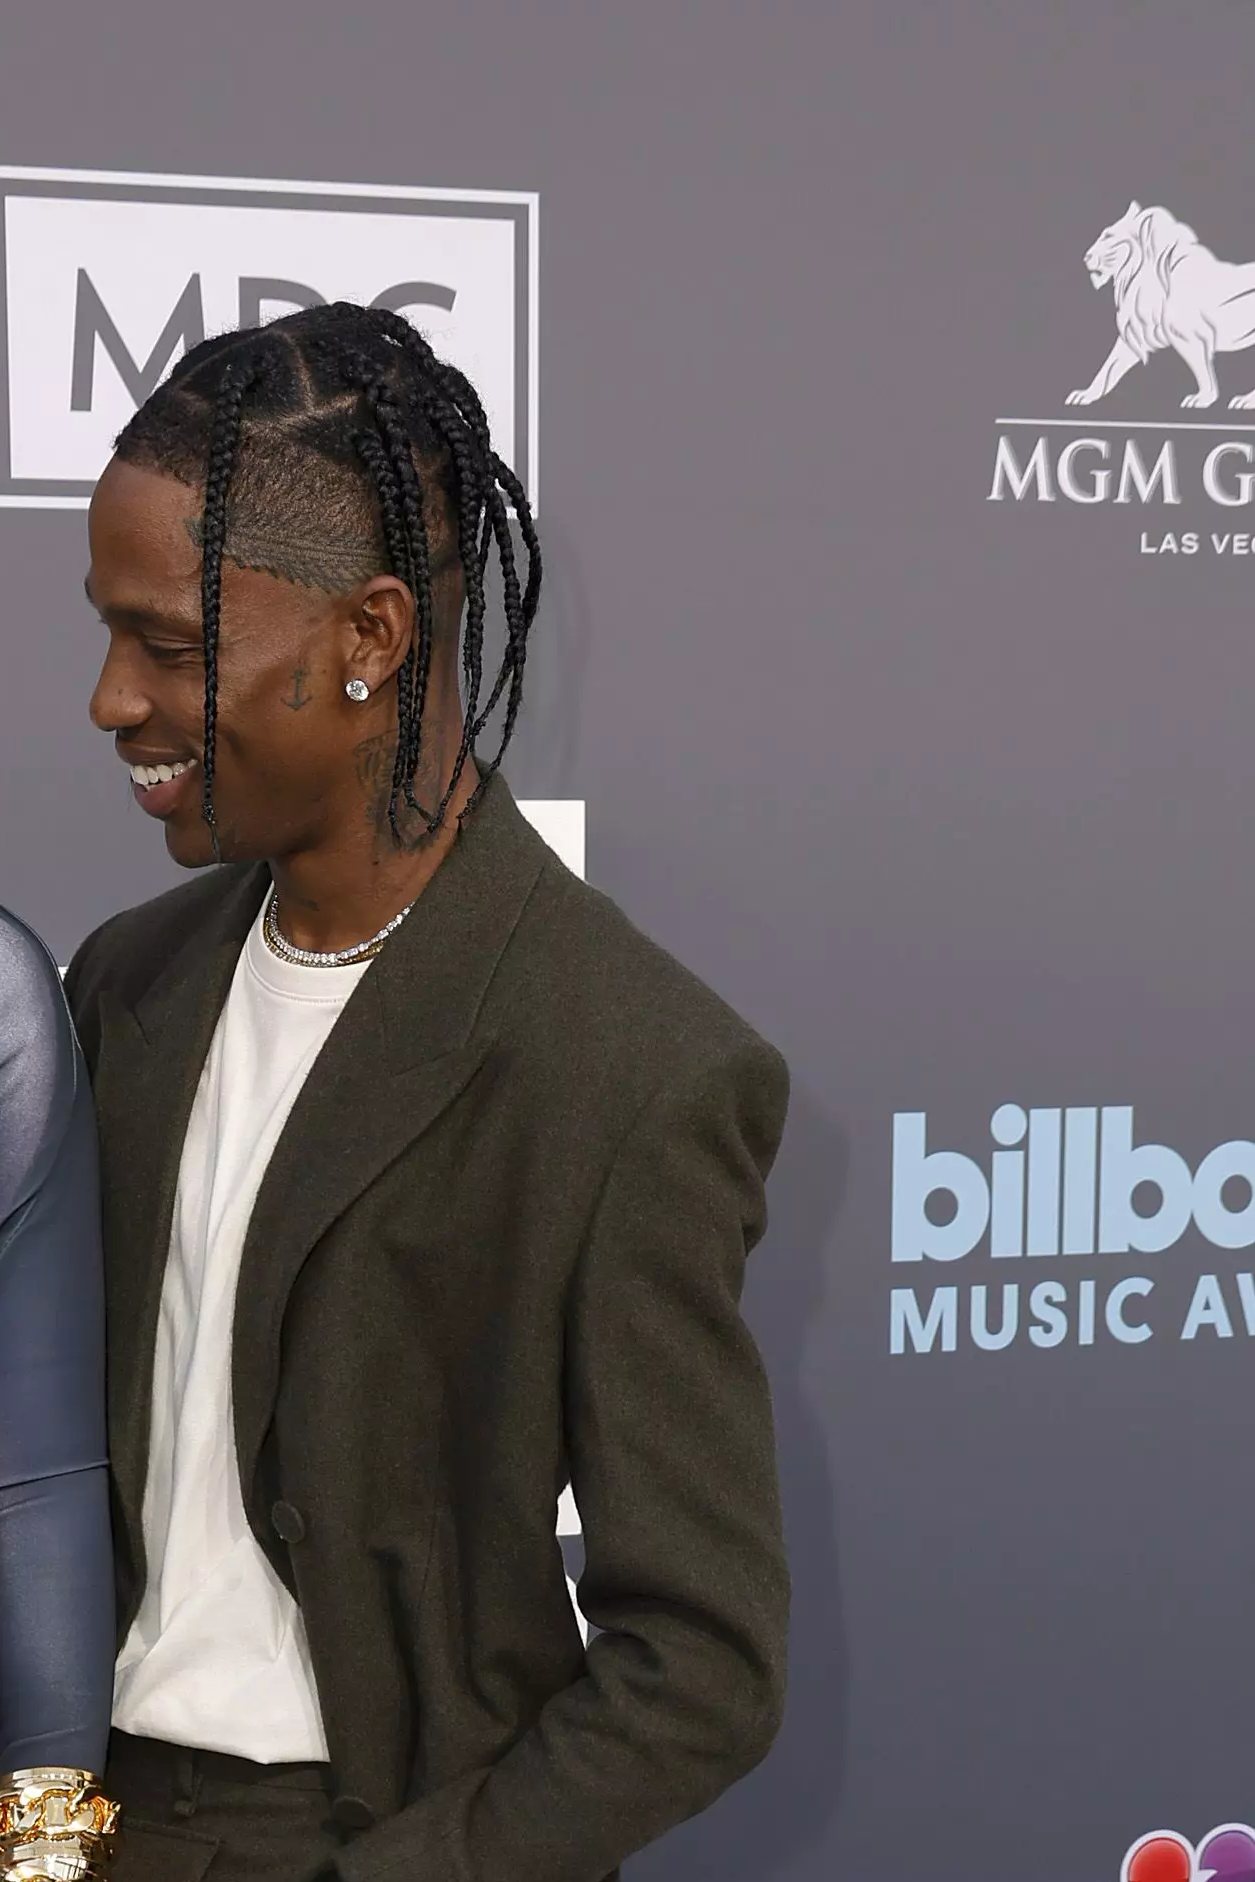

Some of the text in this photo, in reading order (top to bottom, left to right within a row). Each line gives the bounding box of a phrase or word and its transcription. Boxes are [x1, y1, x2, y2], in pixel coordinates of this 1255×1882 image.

[986, 436, 1181, 504] MGM
[1141, 532, 1255, 555] LAS VE
[890, 1272, 1255, 1354] MUSIC A
